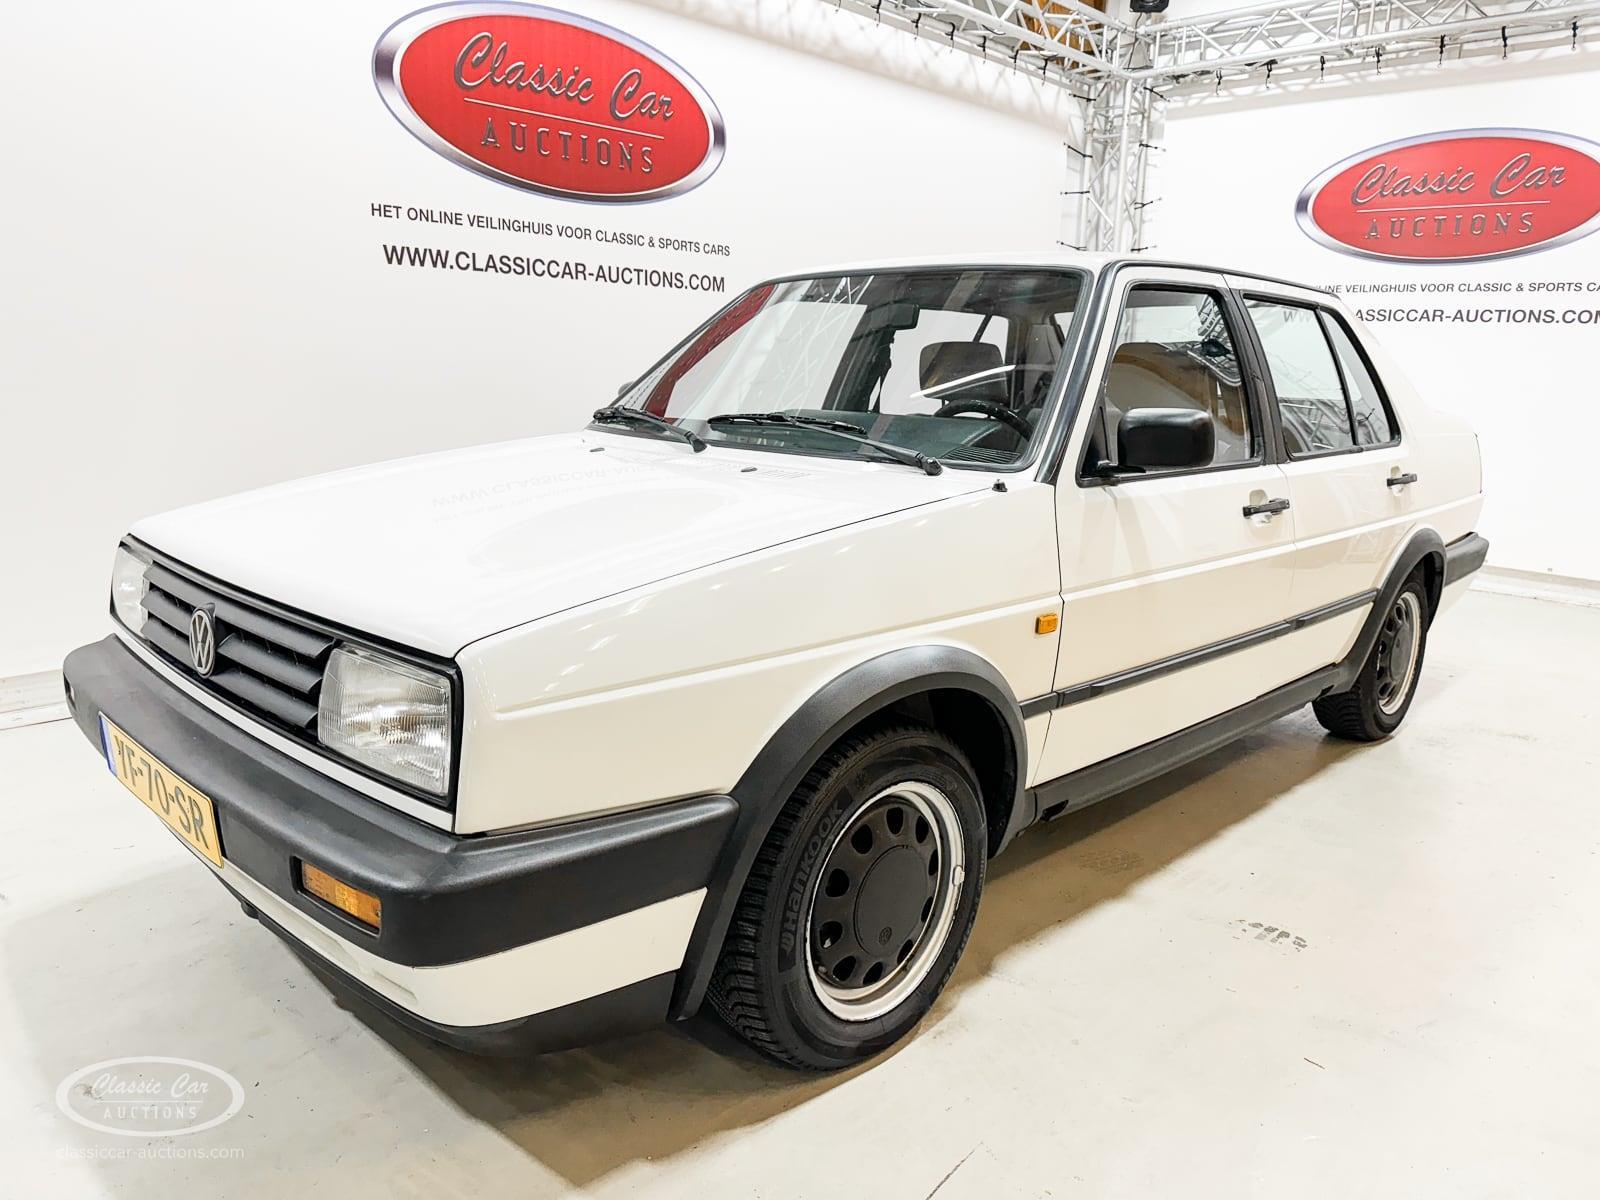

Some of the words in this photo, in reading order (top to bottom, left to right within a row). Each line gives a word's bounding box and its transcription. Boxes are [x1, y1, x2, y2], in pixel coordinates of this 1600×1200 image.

[453, 31, 594, 103] Classic
[609, 68, 674, 121] Car
[480, 117, 653, 174] AUCTIONS
[1351, 163, 1475, 205] Classic
[1489, 152, 1567, 199] Car
[371, 202, 402, 219] HET
[407, 207, 463, 226] ONLINE
[467, 213, 553, 236] VEILINGHUIS
[556, 224, 592, 240] VOOR
[595, 229, 645, 247] CLASSIC
[648, 236, 656, 248] &
[658, 237, 701, 253] SPORTS
[703, 243, 731, 256] CARS
[1365, 212, 1534, 240] AUCTIONS
[382, 244, 726, 293] WWW.CLASSICCAR-AUCTIONS.COM
[1345, 283, 1417, 294] VEILINGHUIS
[1420, 283, 1455, 293] VOOR
[1458, 282, 1512, 293] CLASSIC
[1515, 282, 1524, 292] &
[1528, 282, 1583, 292] SPORTS
[113, 734, 210, 850] YF-70-SR
